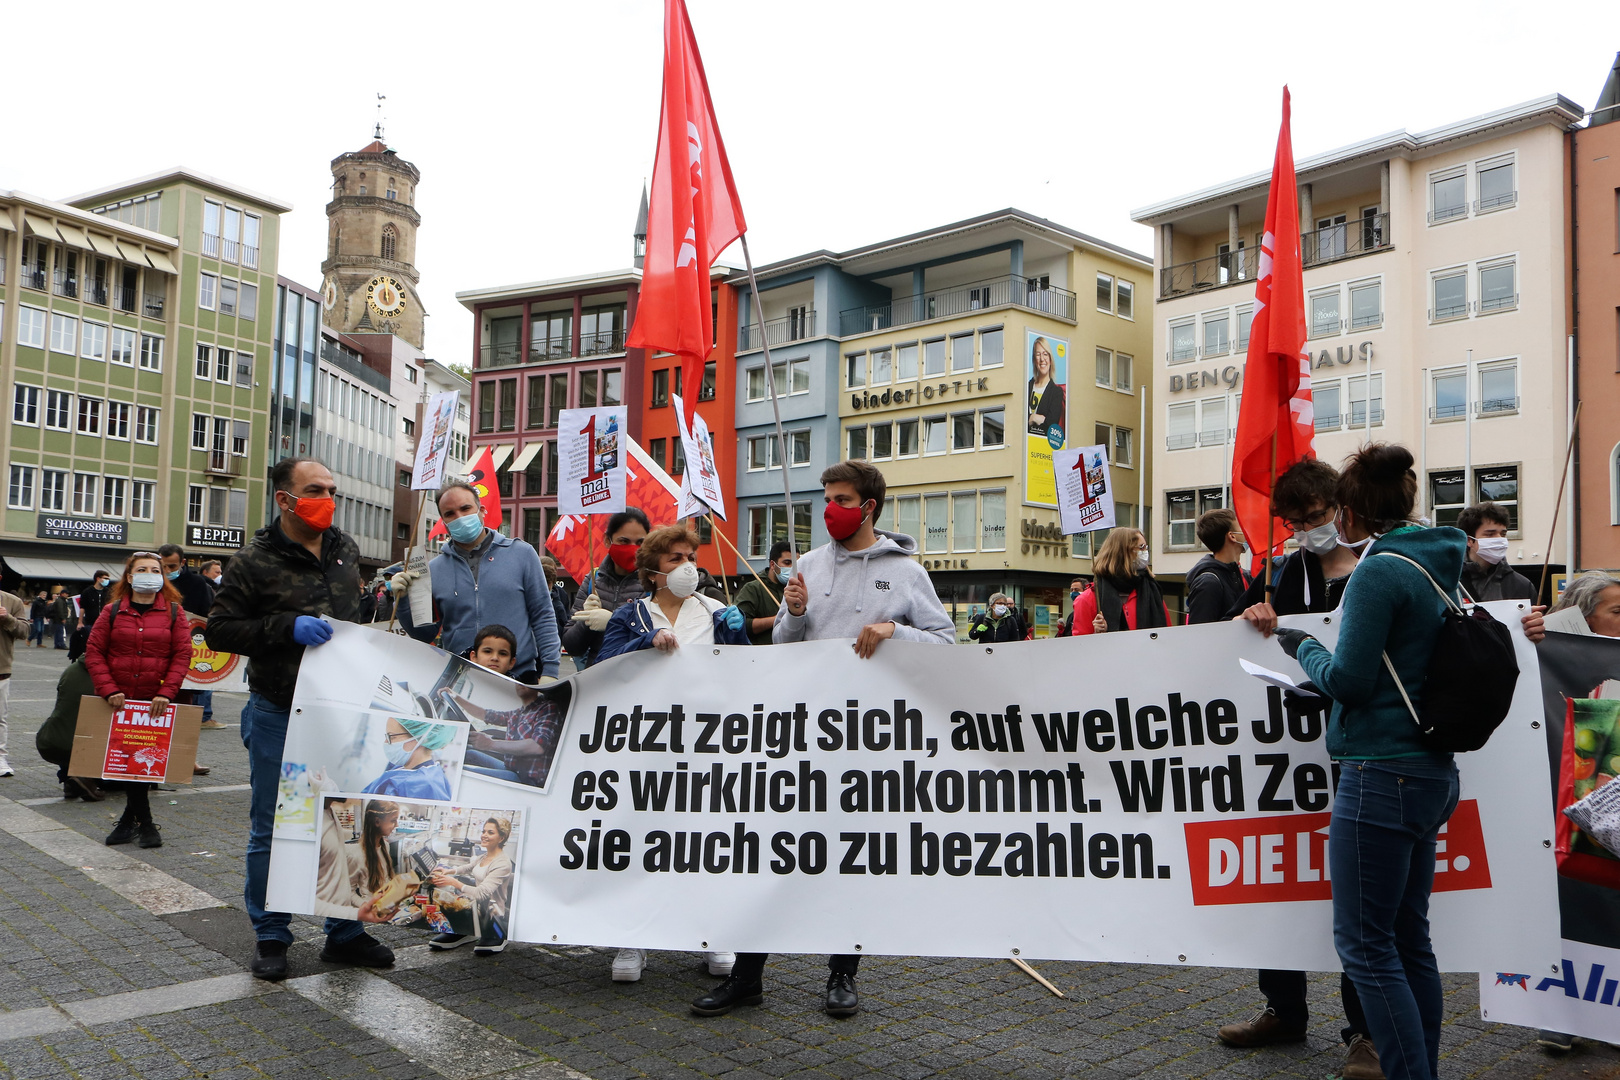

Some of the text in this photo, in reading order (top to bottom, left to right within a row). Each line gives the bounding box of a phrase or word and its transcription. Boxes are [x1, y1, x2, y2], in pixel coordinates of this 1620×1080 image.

[852, 377, 988, 410] binder OPTIK
[580, 414, 604, 485] 1
[581, 472, 609, 497] mai
[1072, 453, 1096, 509] 1
[583, 491, 610, 505] DIE LINKE.
[1080, 497, 1102, 518] mai
[45, 518, 123, 533] SCHLOSSBERG
[928, 526, 947, 534] binder
[45, 529, 122, 540] SWITZERLAND
[204, 528, 241, 543] EPPLI
[1021, 542, 1069, 559] OPTIK
[923, 558, 969, 570] OPTIK
[192, 648, 218, 660] DIDF
[116, 711, 172, 728] 1. Mai
[579, 686, 1328, 759] Jetzt zeigt sich, auf welche Jo
[123, 733, 158, 741] SOLIDARITÄT
[571, 753, 1341, 813] es wirklich ankommt. Wird Ze
[559, 819, 1171, 879] sie auch so zu bezahlen.
[1208, 823, 1470, 888] DIE LE.
